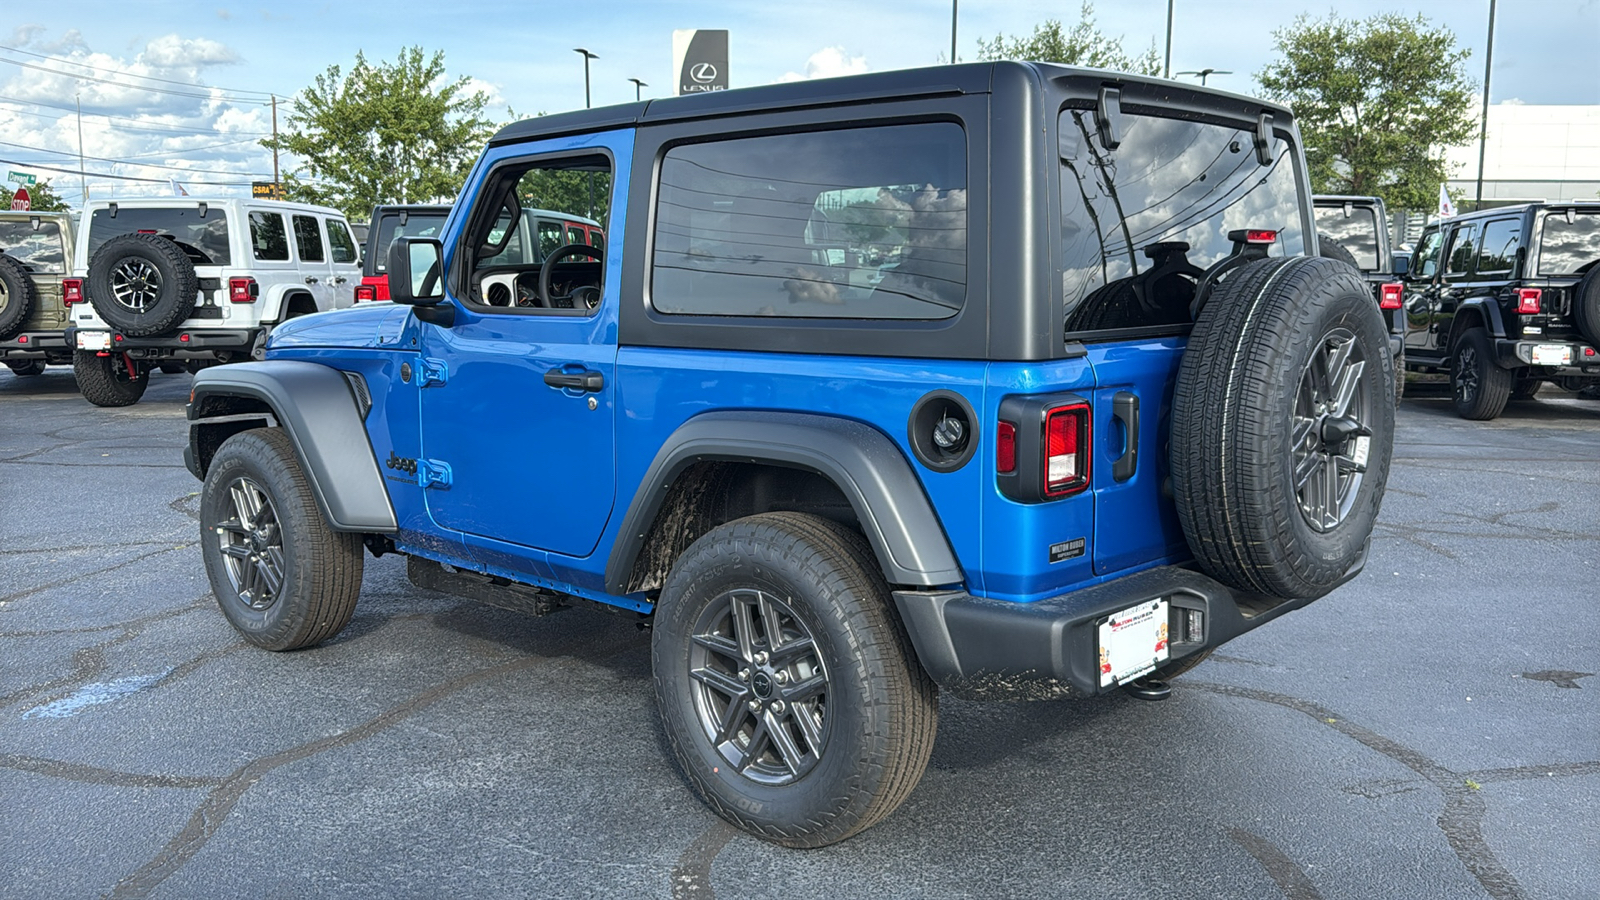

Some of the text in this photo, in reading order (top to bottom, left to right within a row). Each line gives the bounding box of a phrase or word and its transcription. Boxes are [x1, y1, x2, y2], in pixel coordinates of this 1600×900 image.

[9, 173, 29, 184] Davant
[253, 186, 270, 194] CSRA
[12, 200, 30, 211] STOP
[386, 451, 417, 476] Jeep
[1051, 539, 1084, 555] MILTON RUBEN
[1112, 618, 1133, 628] MILTON
[1133, 611, 1154, 621] RUBEN
[1120, 616, 1154, 630] SUPERSTORE
